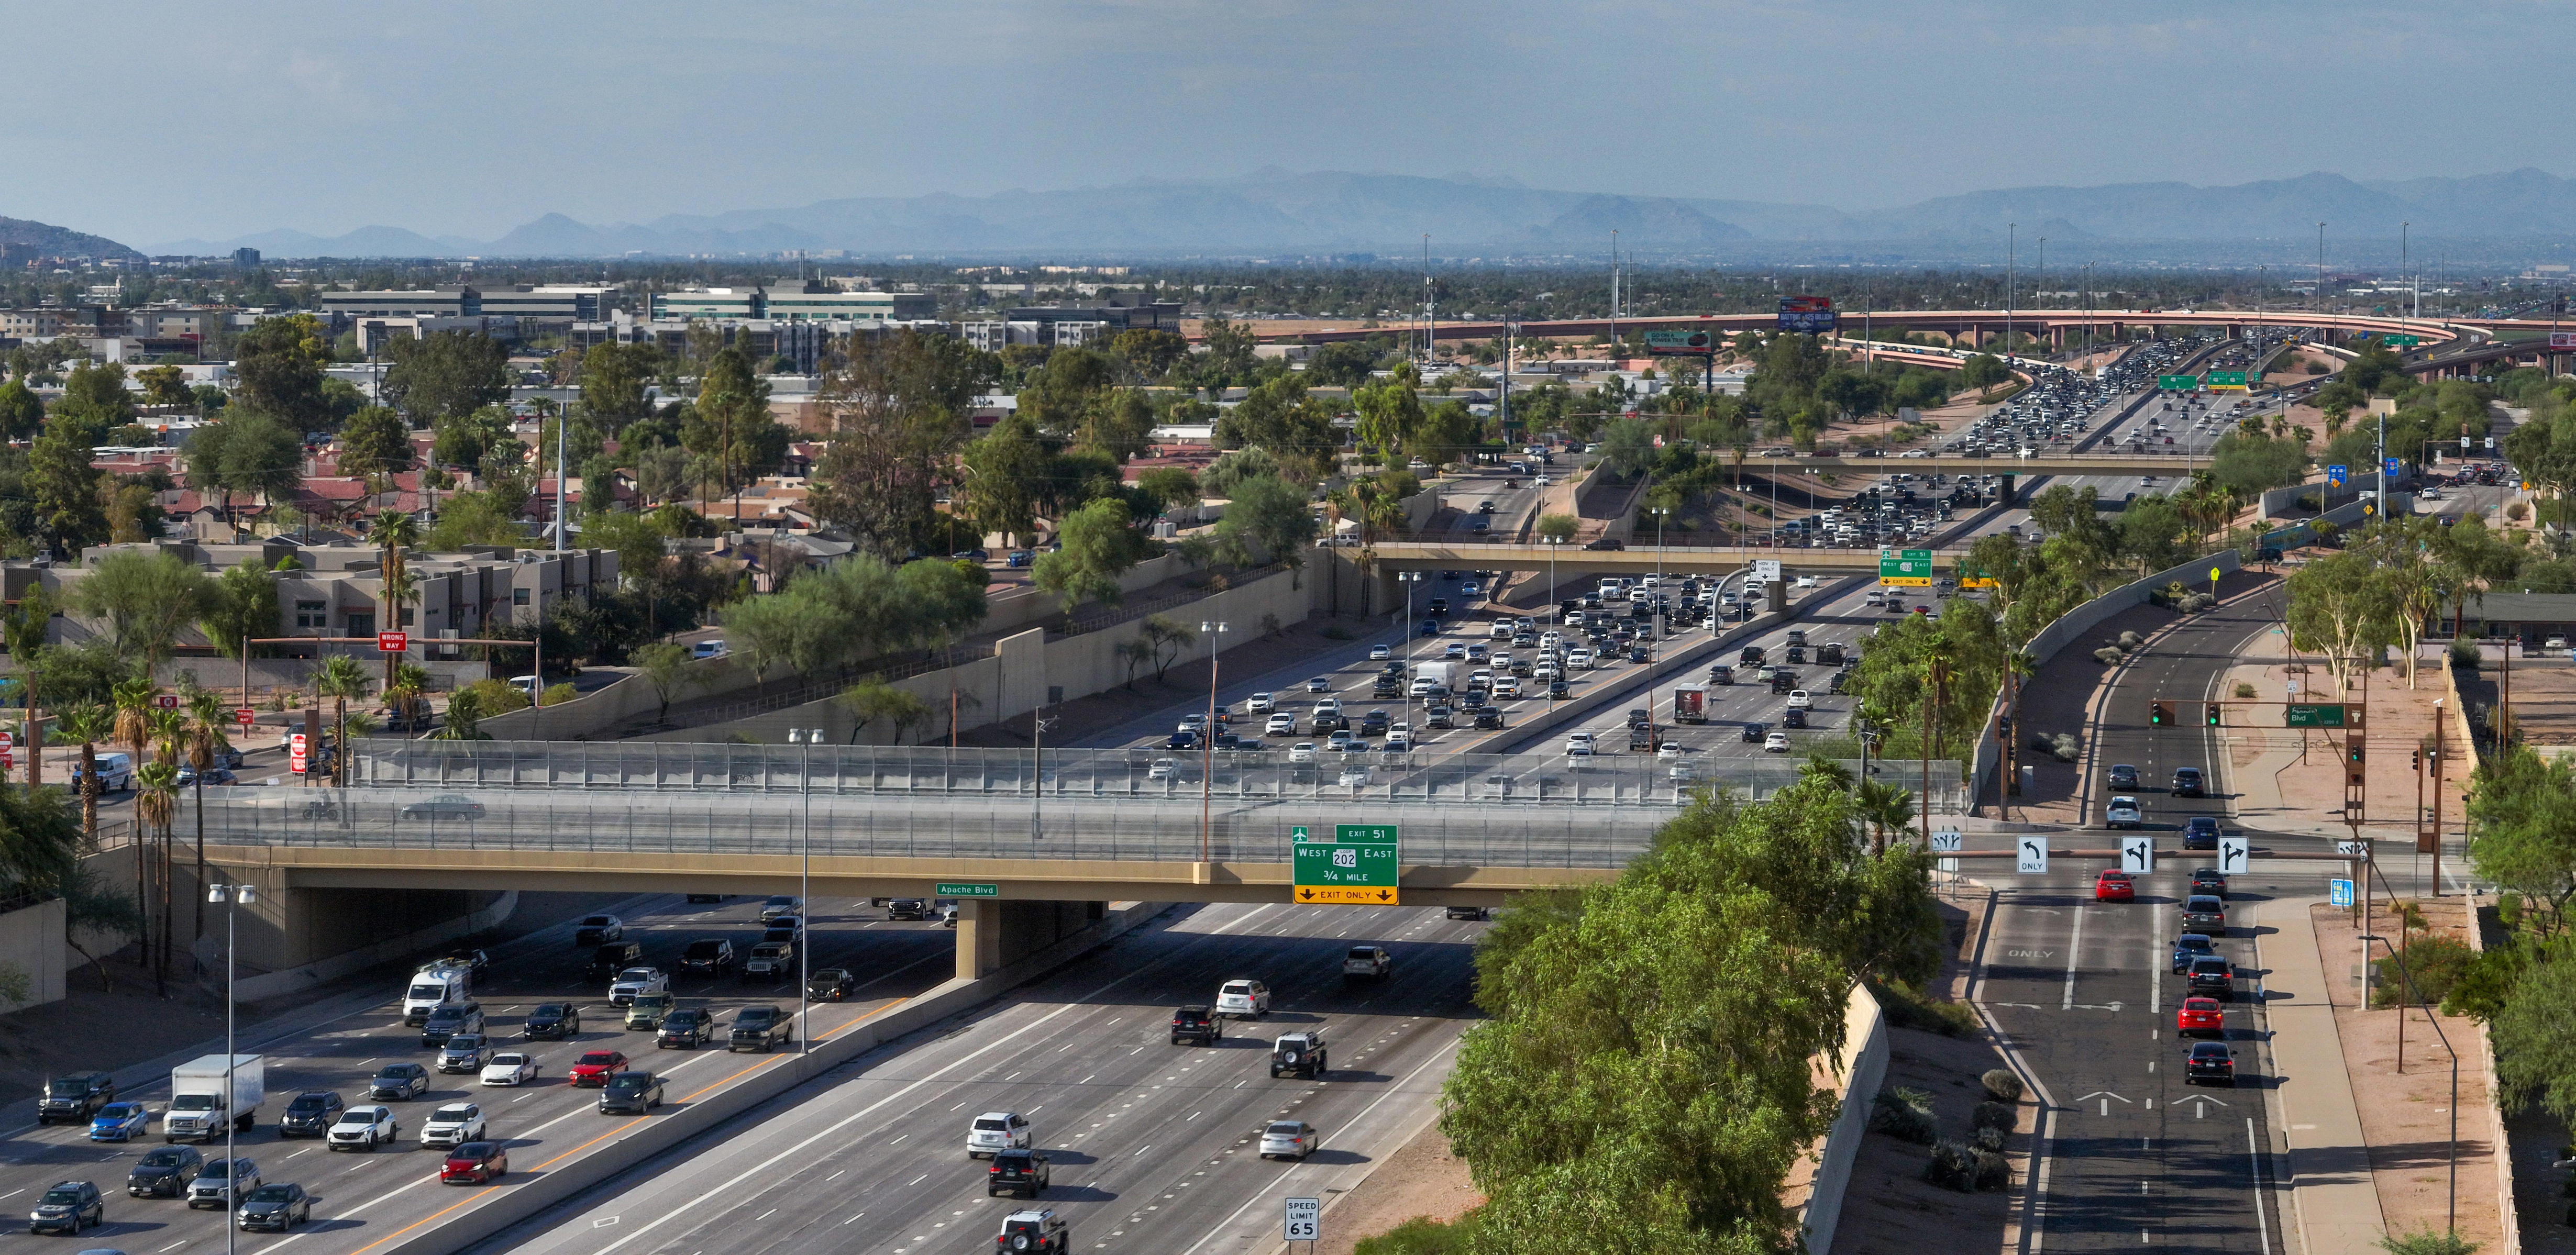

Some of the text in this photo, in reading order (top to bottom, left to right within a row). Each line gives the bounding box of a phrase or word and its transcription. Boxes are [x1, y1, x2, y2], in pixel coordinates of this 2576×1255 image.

[1373, 830, 1385, 839] 51
[1299, 848, 1326, 857] WEST
[1364, 849, 1392, 858] EAST
[1334, 854, 1355, 864] 202
[941, 886, 971, 894] Apache
[2008, 950, 2053, 958] ONLY
[1290, 1223, 1313, 1235] 65
